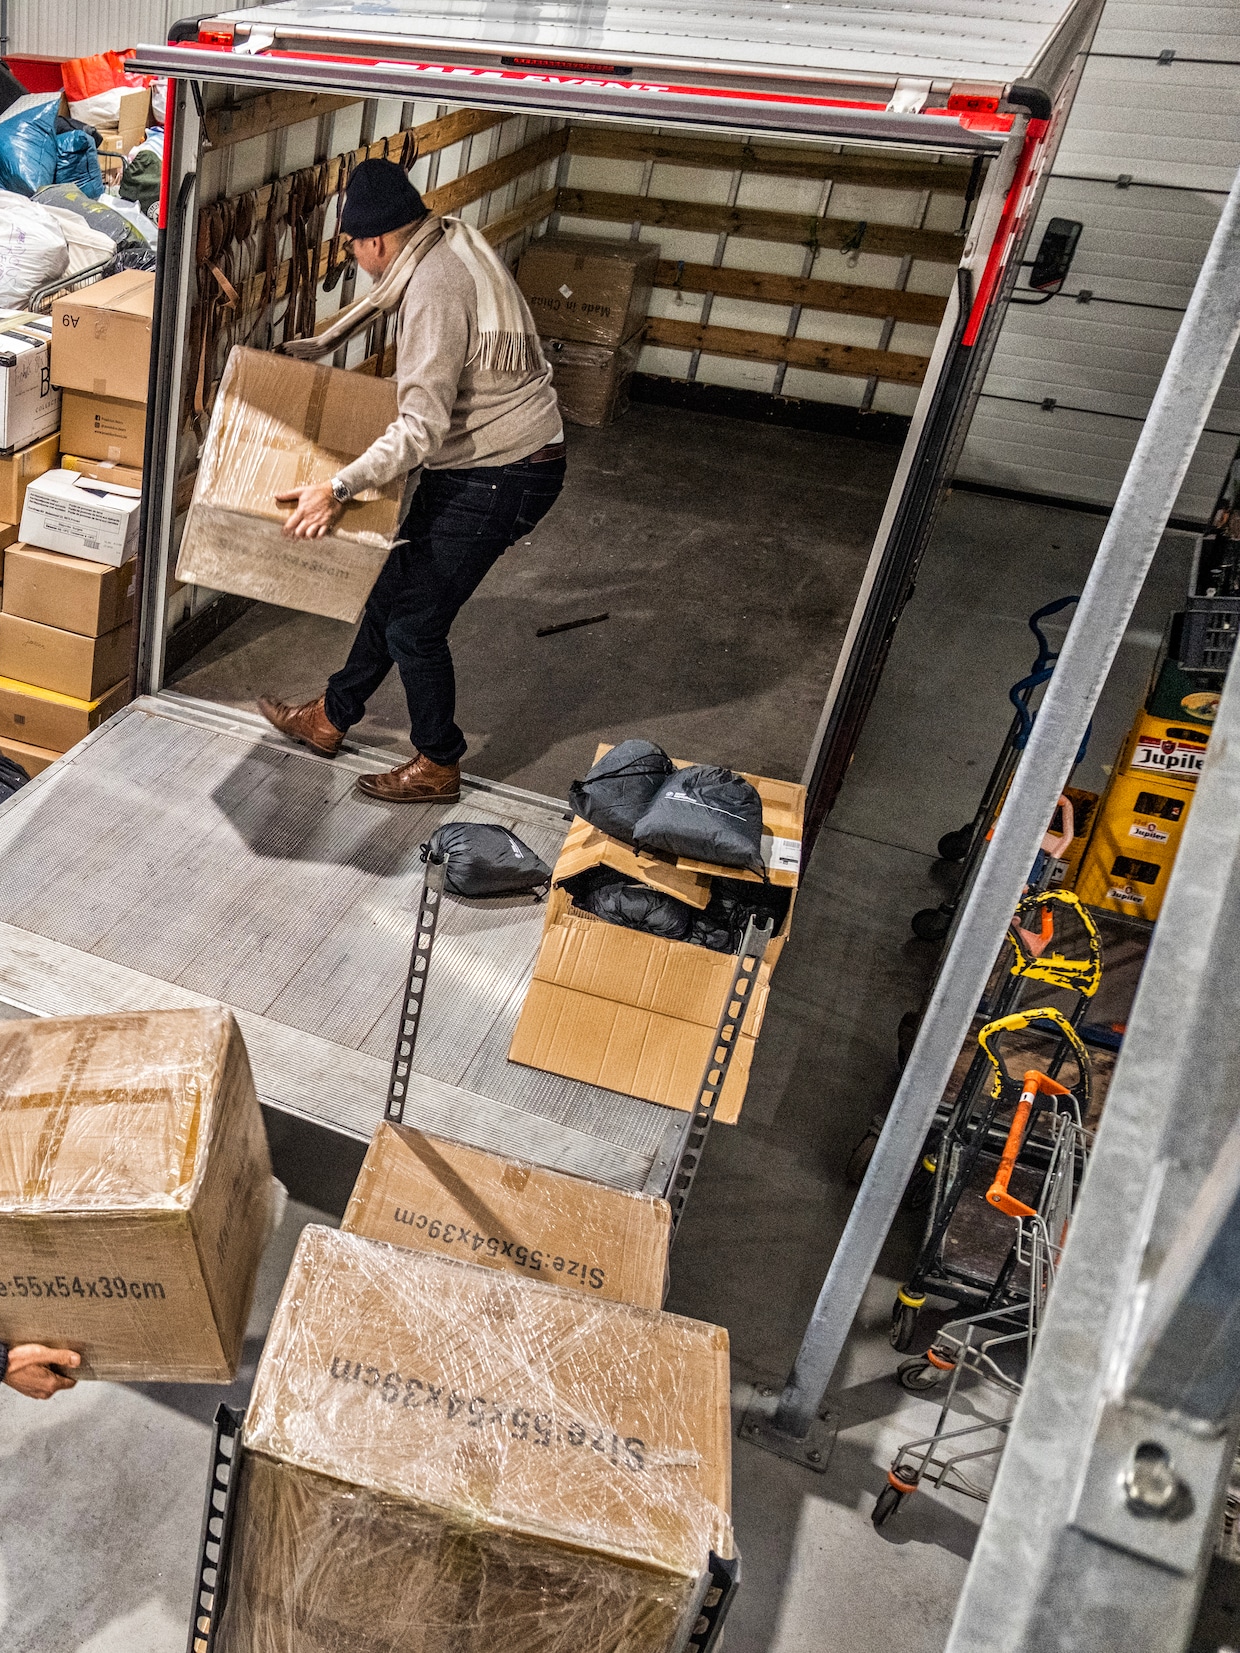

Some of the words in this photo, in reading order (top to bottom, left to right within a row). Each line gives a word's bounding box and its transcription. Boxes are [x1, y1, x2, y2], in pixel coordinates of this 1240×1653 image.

[566, 301, 576, 312] in
[581, 302, 611, 318] Made
[62, 314, 80, 329] A9
[1137, 748, 1206, 771] Jupile
[1134, 827, 1167, 841] Jupiler
[1111, 889, 1144, 904] Jupiler
[393, 1206, 606, 1290] Size:55x54x39cm
[329, 1356, 647, 1473] Size:55x54x39cm
